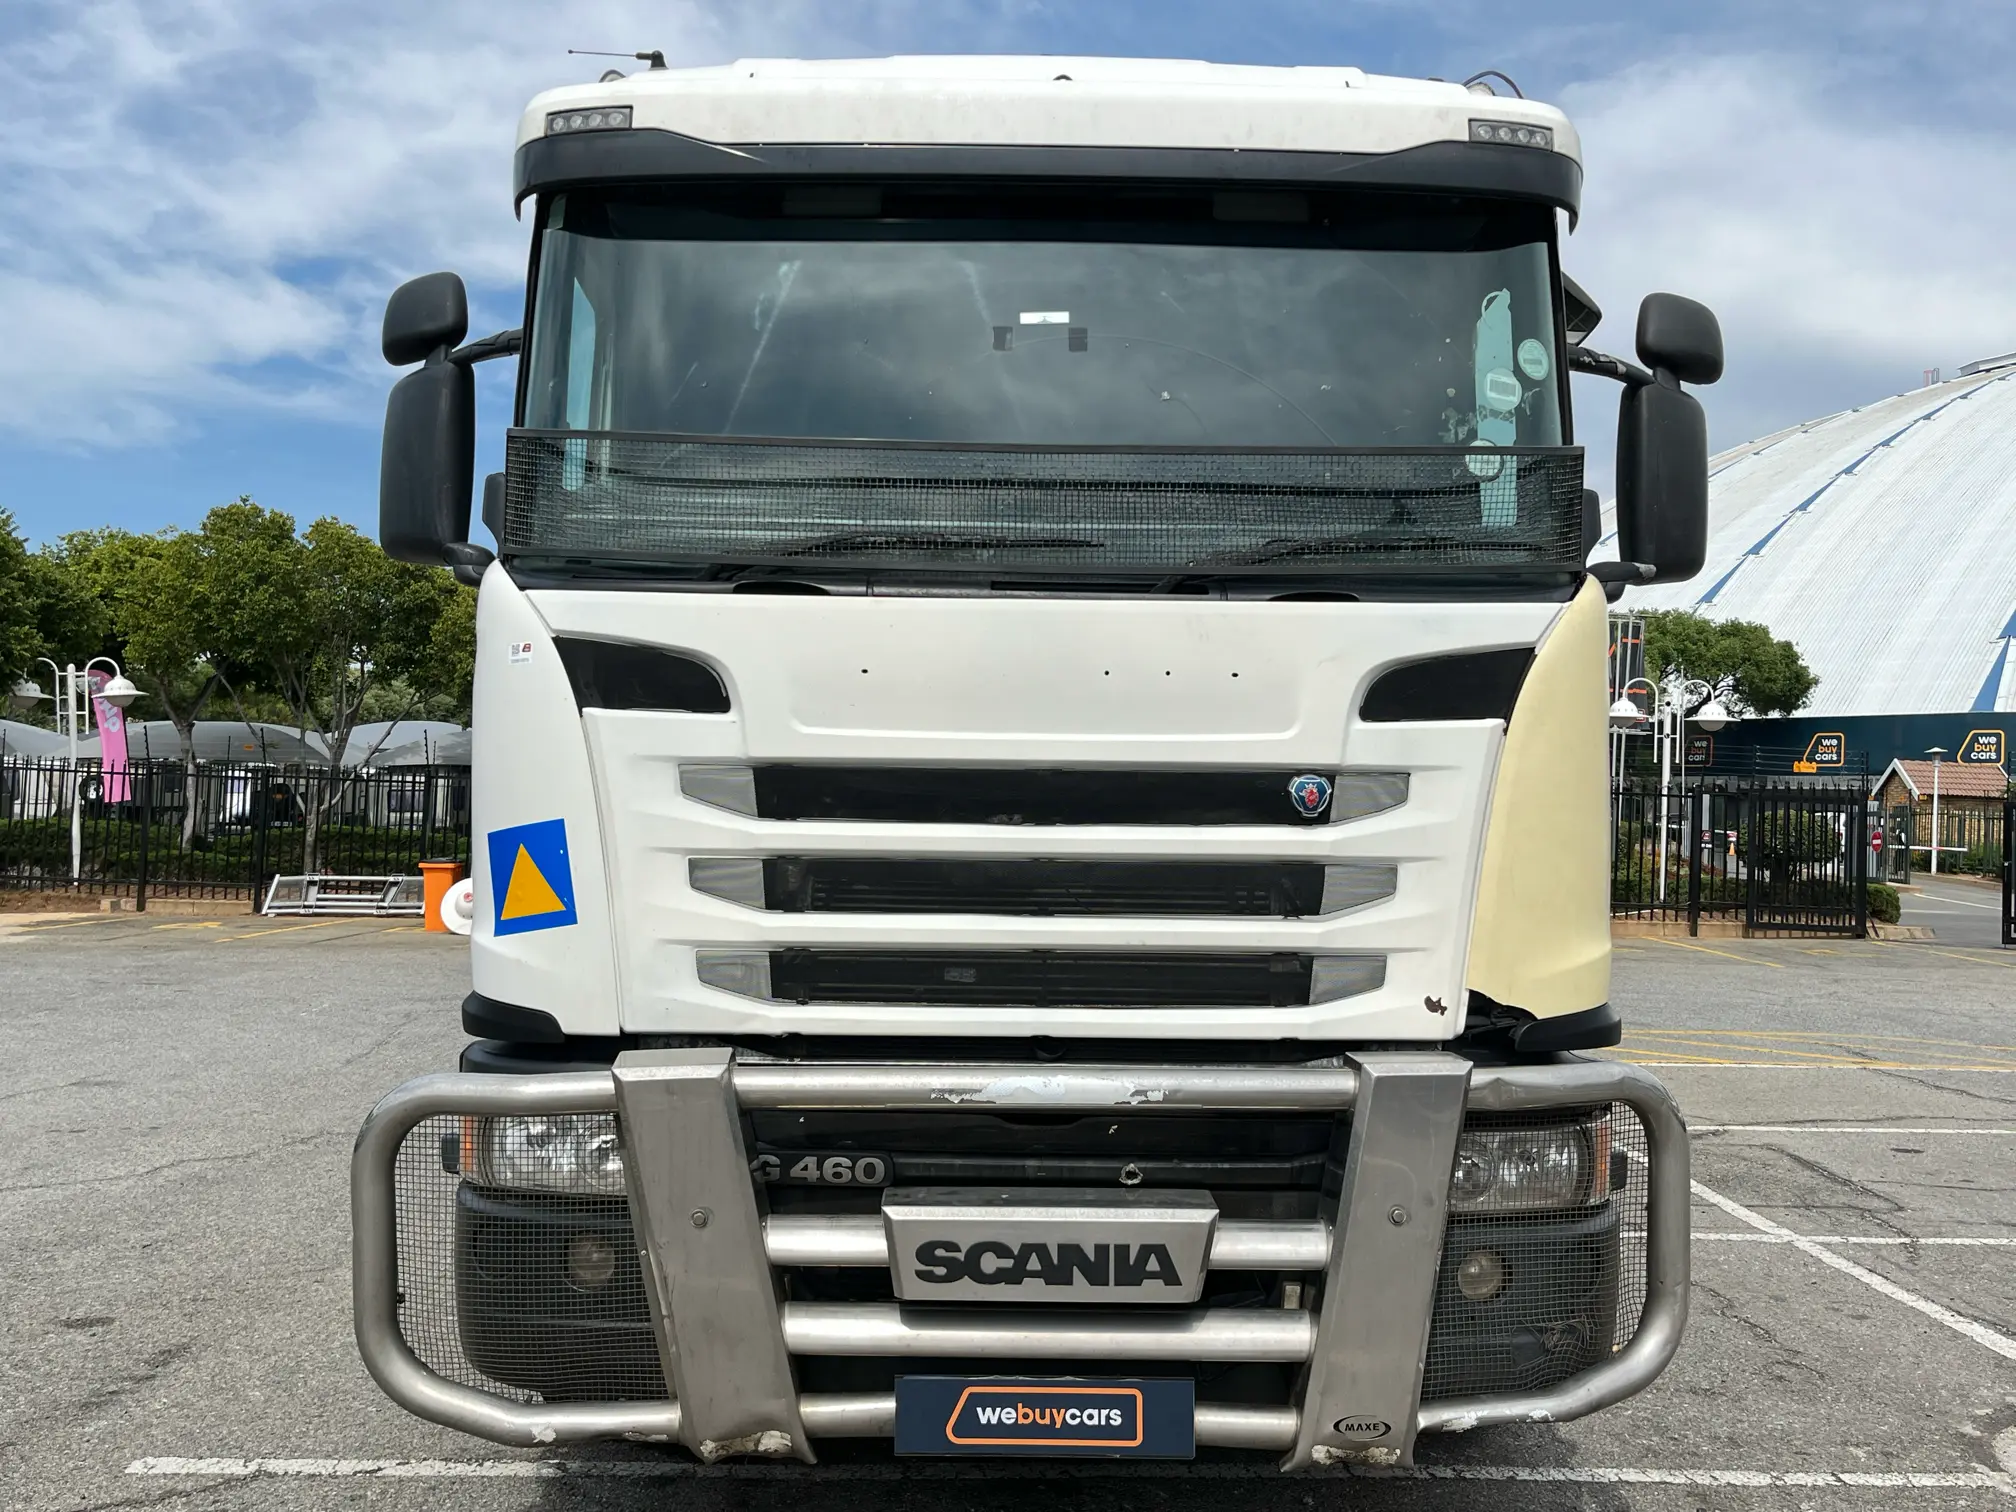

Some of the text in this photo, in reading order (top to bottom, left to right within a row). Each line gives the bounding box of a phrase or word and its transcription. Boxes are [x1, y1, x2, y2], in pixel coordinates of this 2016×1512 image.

[1693, 740, 1708, 748] we
[1821, 738, 1838, 746] we
[1978, 736, 1997, 744] we
[1818, 745, 1838, 754] buy
[1974, 742, 1997, 753] buy
[1815, 753, 1838, 761] cars
[1970, 752, 1997, 760] cars
[789, 1155, 885, 1185] 460
[914, 1240, 1183, 1287] SCANIA
[976, 1402, 1122, 1429] webuycars
[1344, 1422, 1380, 1432] MAXE
